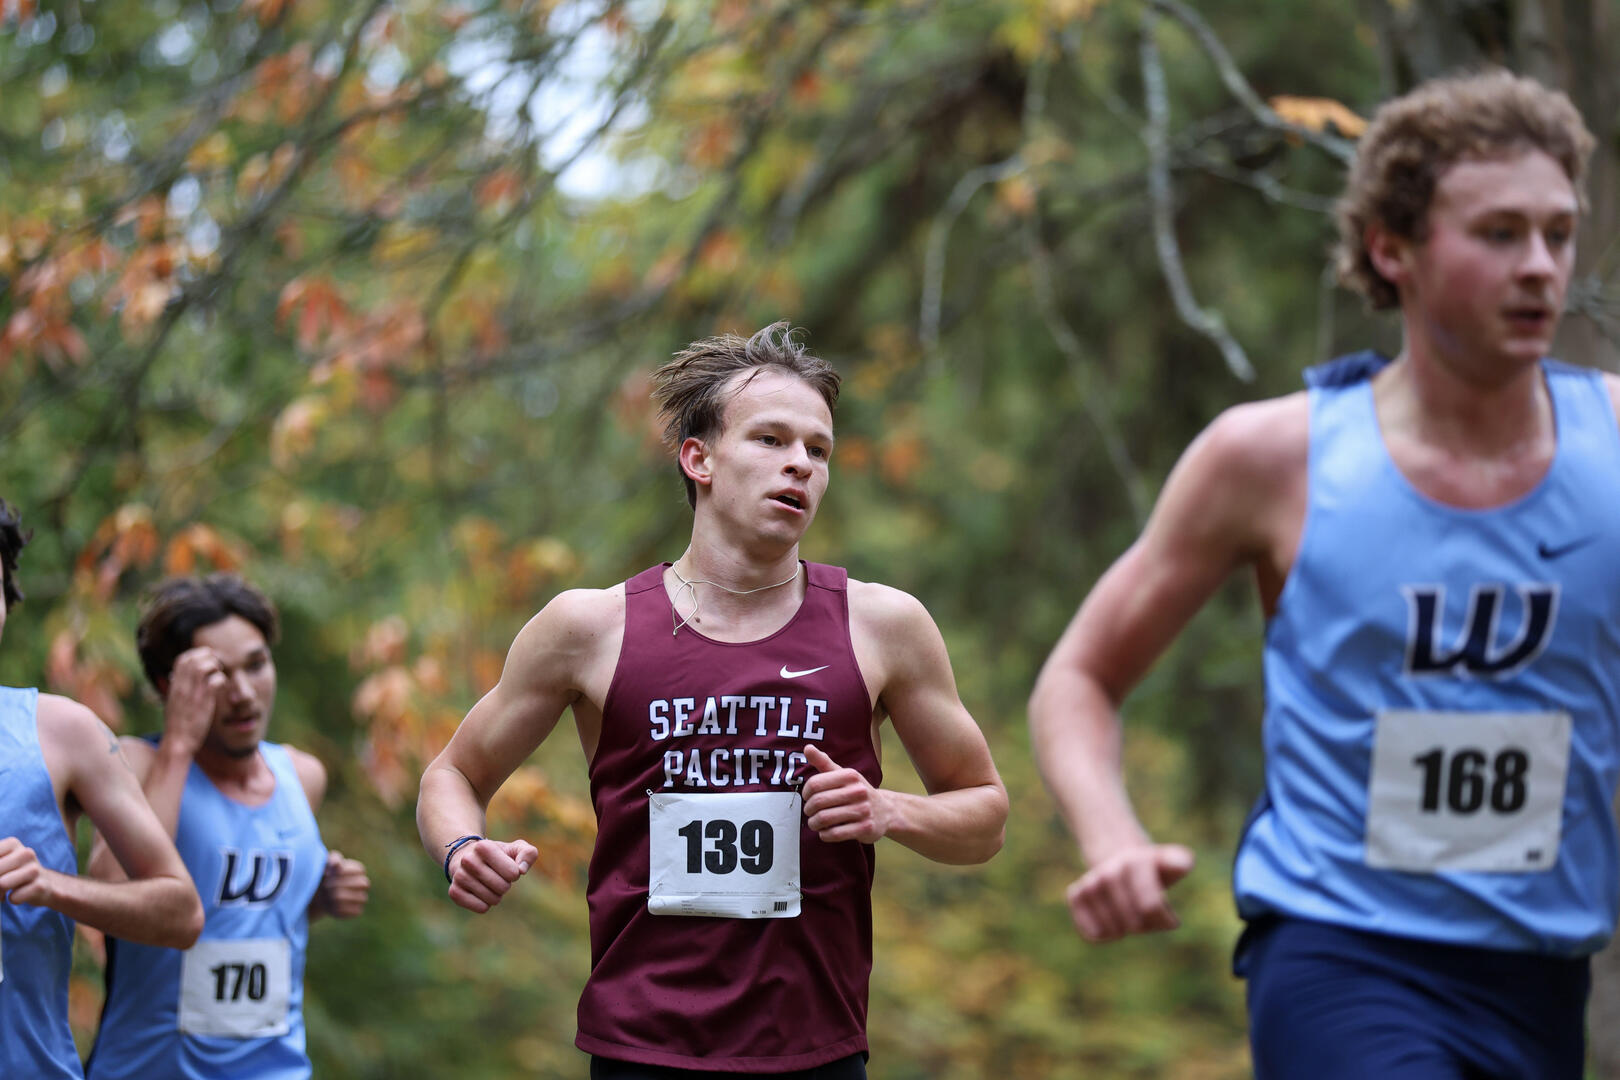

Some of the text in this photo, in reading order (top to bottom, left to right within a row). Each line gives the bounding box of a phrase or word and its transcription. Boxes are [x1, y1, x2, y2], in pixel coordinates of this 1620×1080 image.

[1400, 582, 1560, 681] W
[649, 695, 828, 741] SEATTLE
[663, 748, 808, 788] PACIFIC
[1412, 745, 1530, 817] 168
[678, 819, 774, 875] 139
[214, 846, 294, 909] W
[210, 961, 268, 1002] 170
